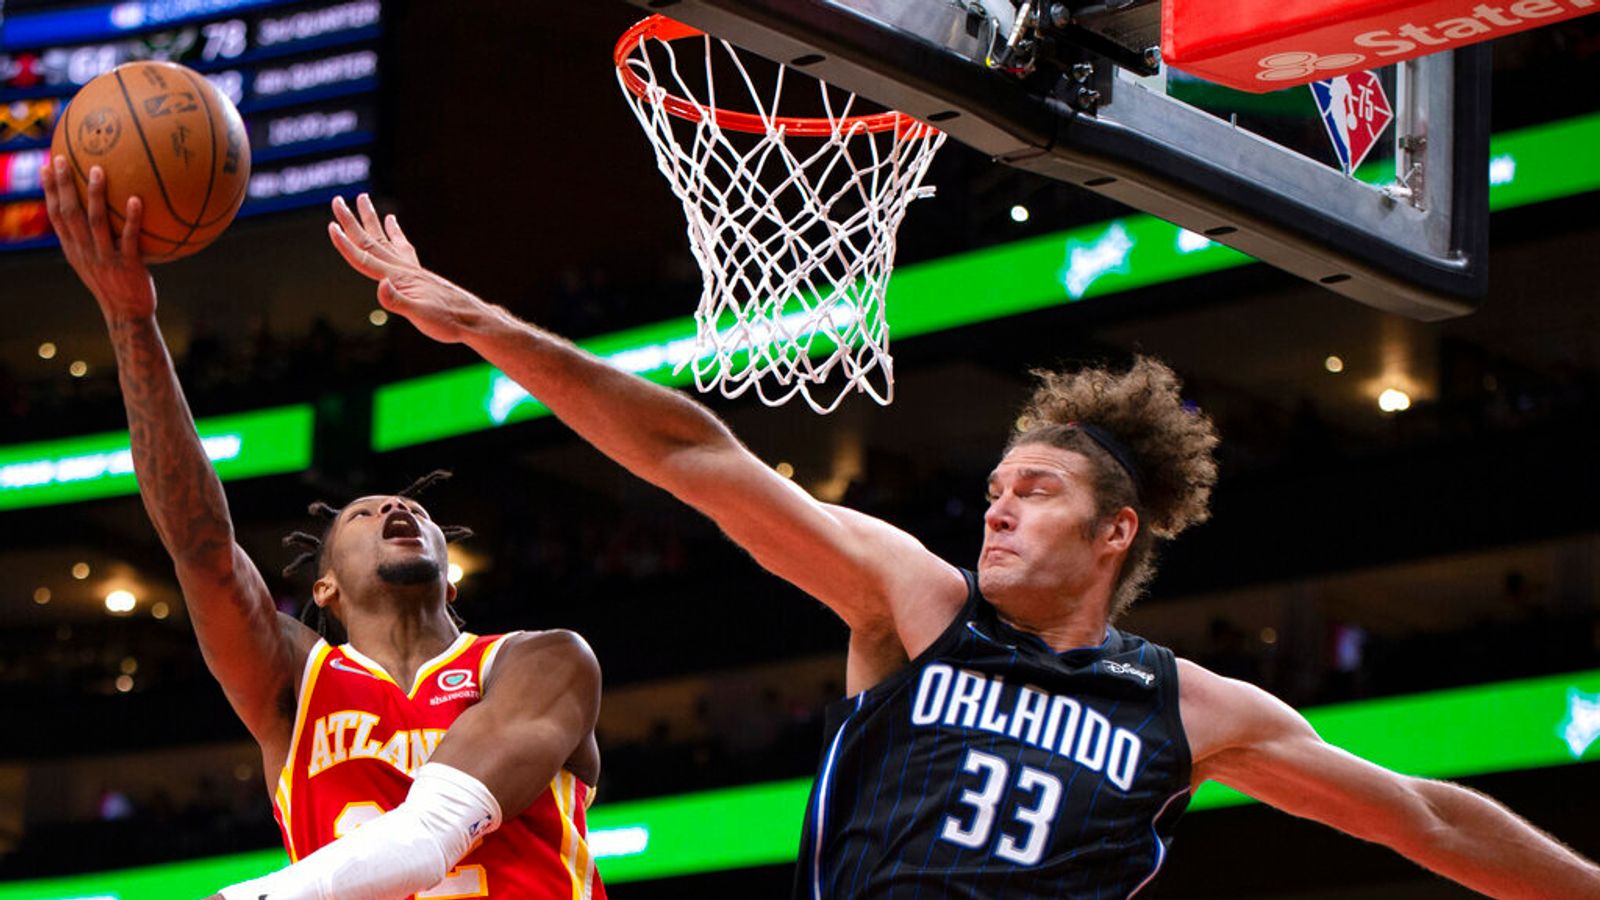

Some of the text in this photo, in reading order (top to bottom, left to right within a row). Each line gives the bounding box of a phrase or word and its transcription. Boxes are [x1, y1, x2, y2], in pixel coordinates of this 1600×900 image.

[1353, 0, 1565, 57] State
[1357, 83, 1374, 122] 75
[308, 710, 449, 780] ATLAN
[911, 663, 1142, 792] ORLANDO
[940, 748, 1063, 866] 33
